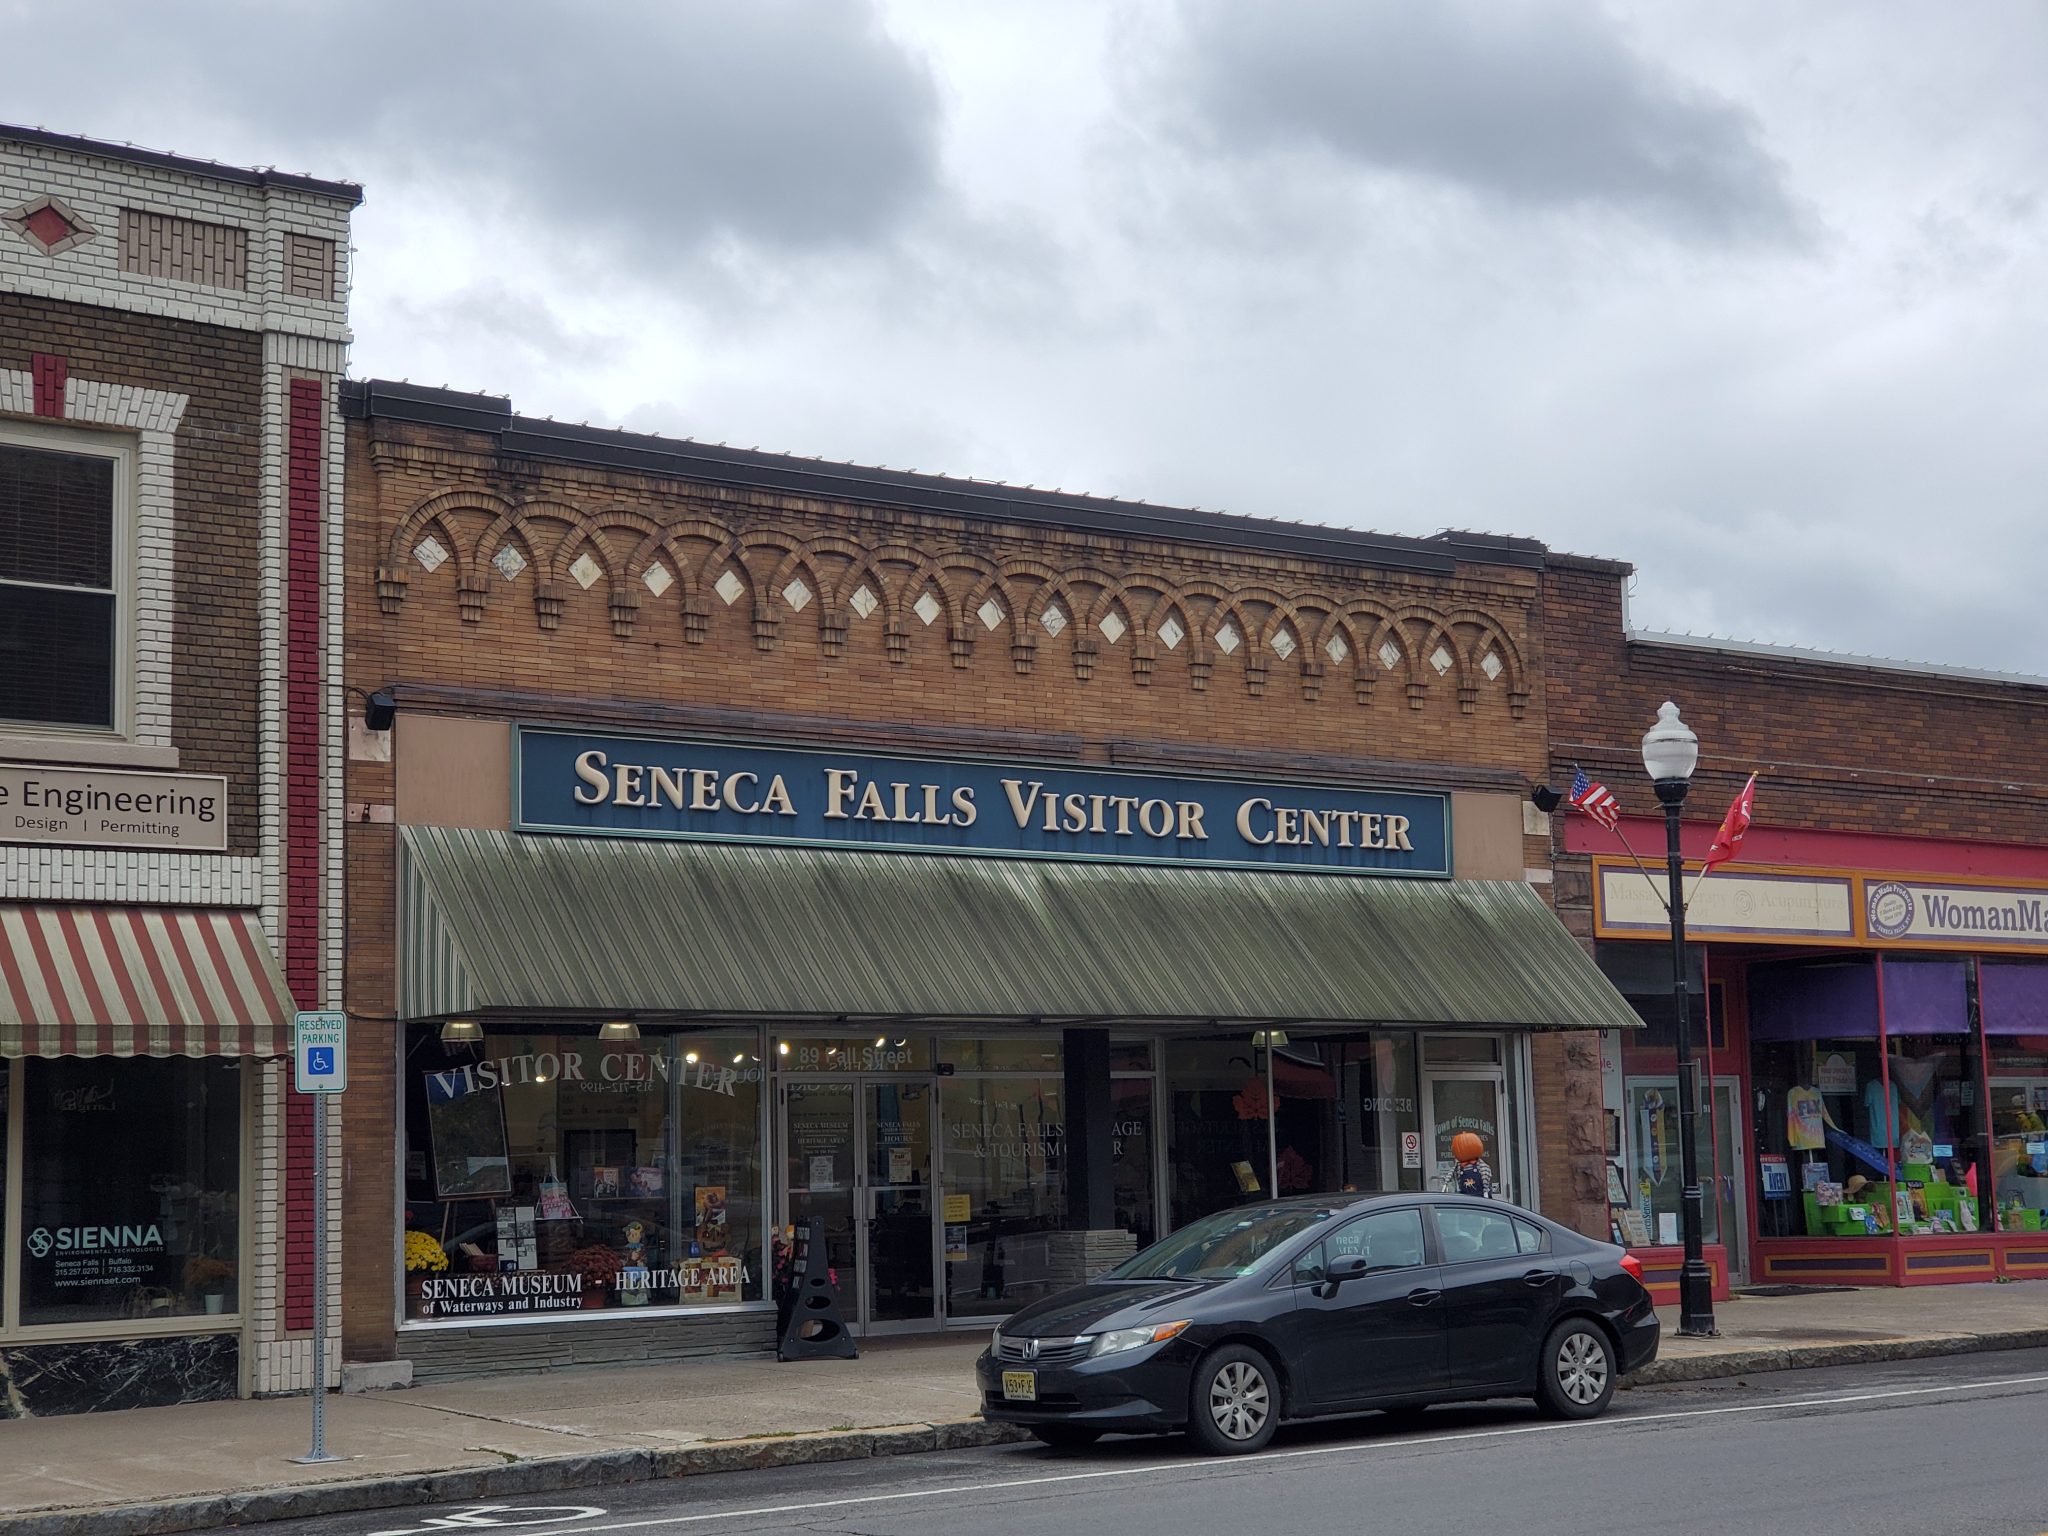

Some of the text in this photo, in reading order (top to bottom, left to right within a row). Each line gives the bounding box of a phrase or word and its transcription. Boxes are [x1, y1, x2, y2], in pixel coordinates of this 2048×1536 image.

[23, 781, 215, 822] Engineering
[574, 750, 1414, 851] SENECA FALLS VISITOR CENTER
[15, 815, 180, 838] Design Permitting
[299, 1020, 341, 1030] RESERVED
[302, 1034, 340, 1044] PARKING
[800, 1047, 819, 1064] 89
[862, 1046, 913, 1064] Street
[434, 1052, 736, 1099] VISITOR CENTER
[952, 1123, 1013, 1139] SENECA
[1018, 1122, 1064, 1137] FALLS
[1458, 1116, 1479, 1129] Seneca
[884, 1135, 913, 1143] HOURS
[973, 1144, 1060, 1158] & TOURISM
[55, 1224, 163, 1250] SIENNA
[114, 1246, 164, 1254] TECHNOLOGIES
[55, 1276, 141, 1287] www.siennaet.com
[421, 1265, 751, 1300] SENECA MUSEUM HERITAGE AREA
[422, 1296, 583, 1314] of Waterways and Industry
